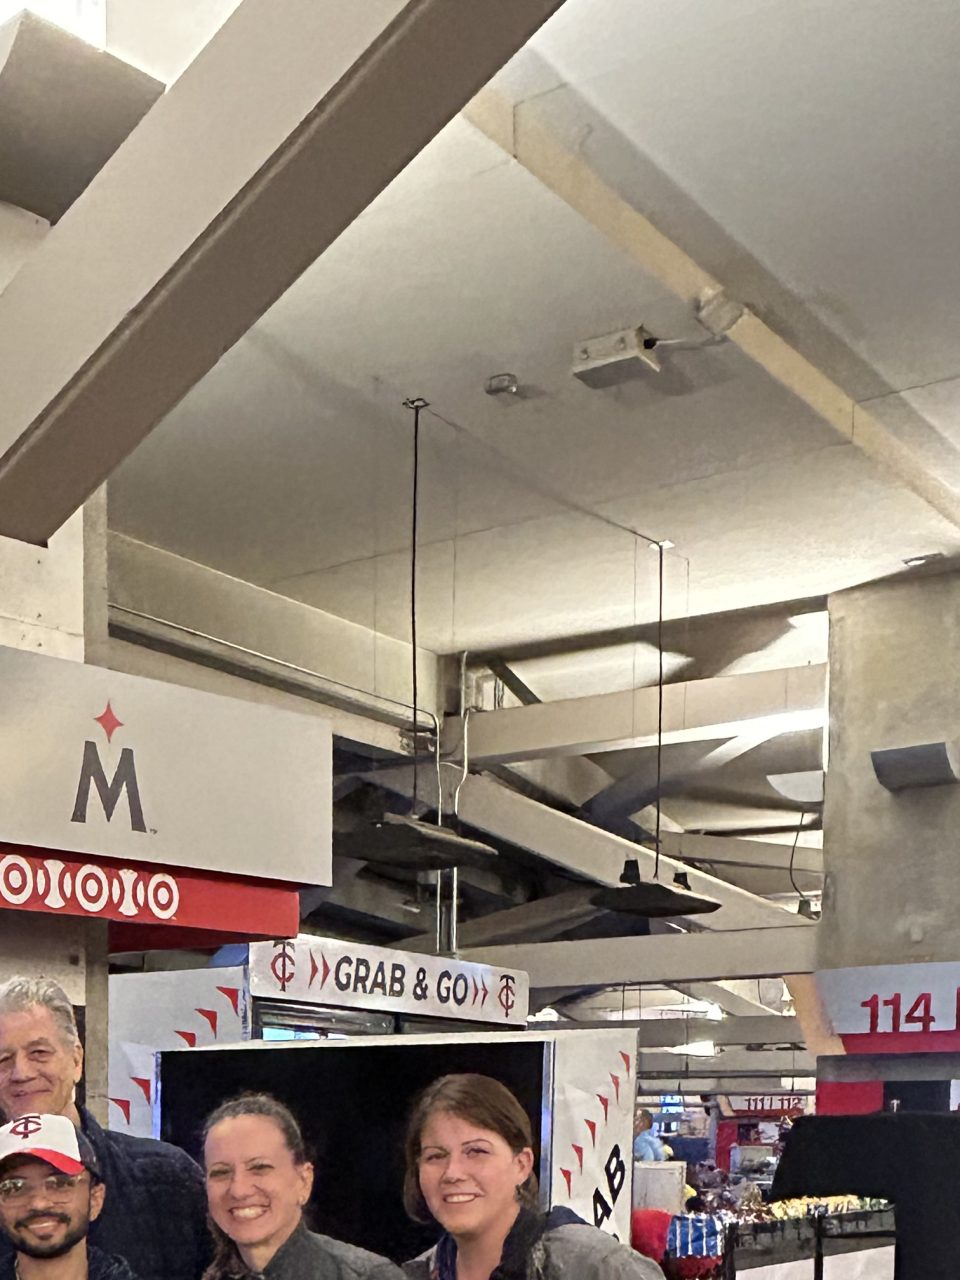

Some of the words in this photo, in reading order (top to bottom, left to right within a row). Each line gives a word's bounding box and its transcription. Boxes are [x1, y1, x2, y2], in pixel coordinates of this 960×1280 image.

[334, 955, 406, 998] GRAB
[412, 967, 428, 1000] &
[436, 970, 468, 1006] GO
[860, 992, 936, 1033] 114
[592, 1143, 626, 1228] AB
